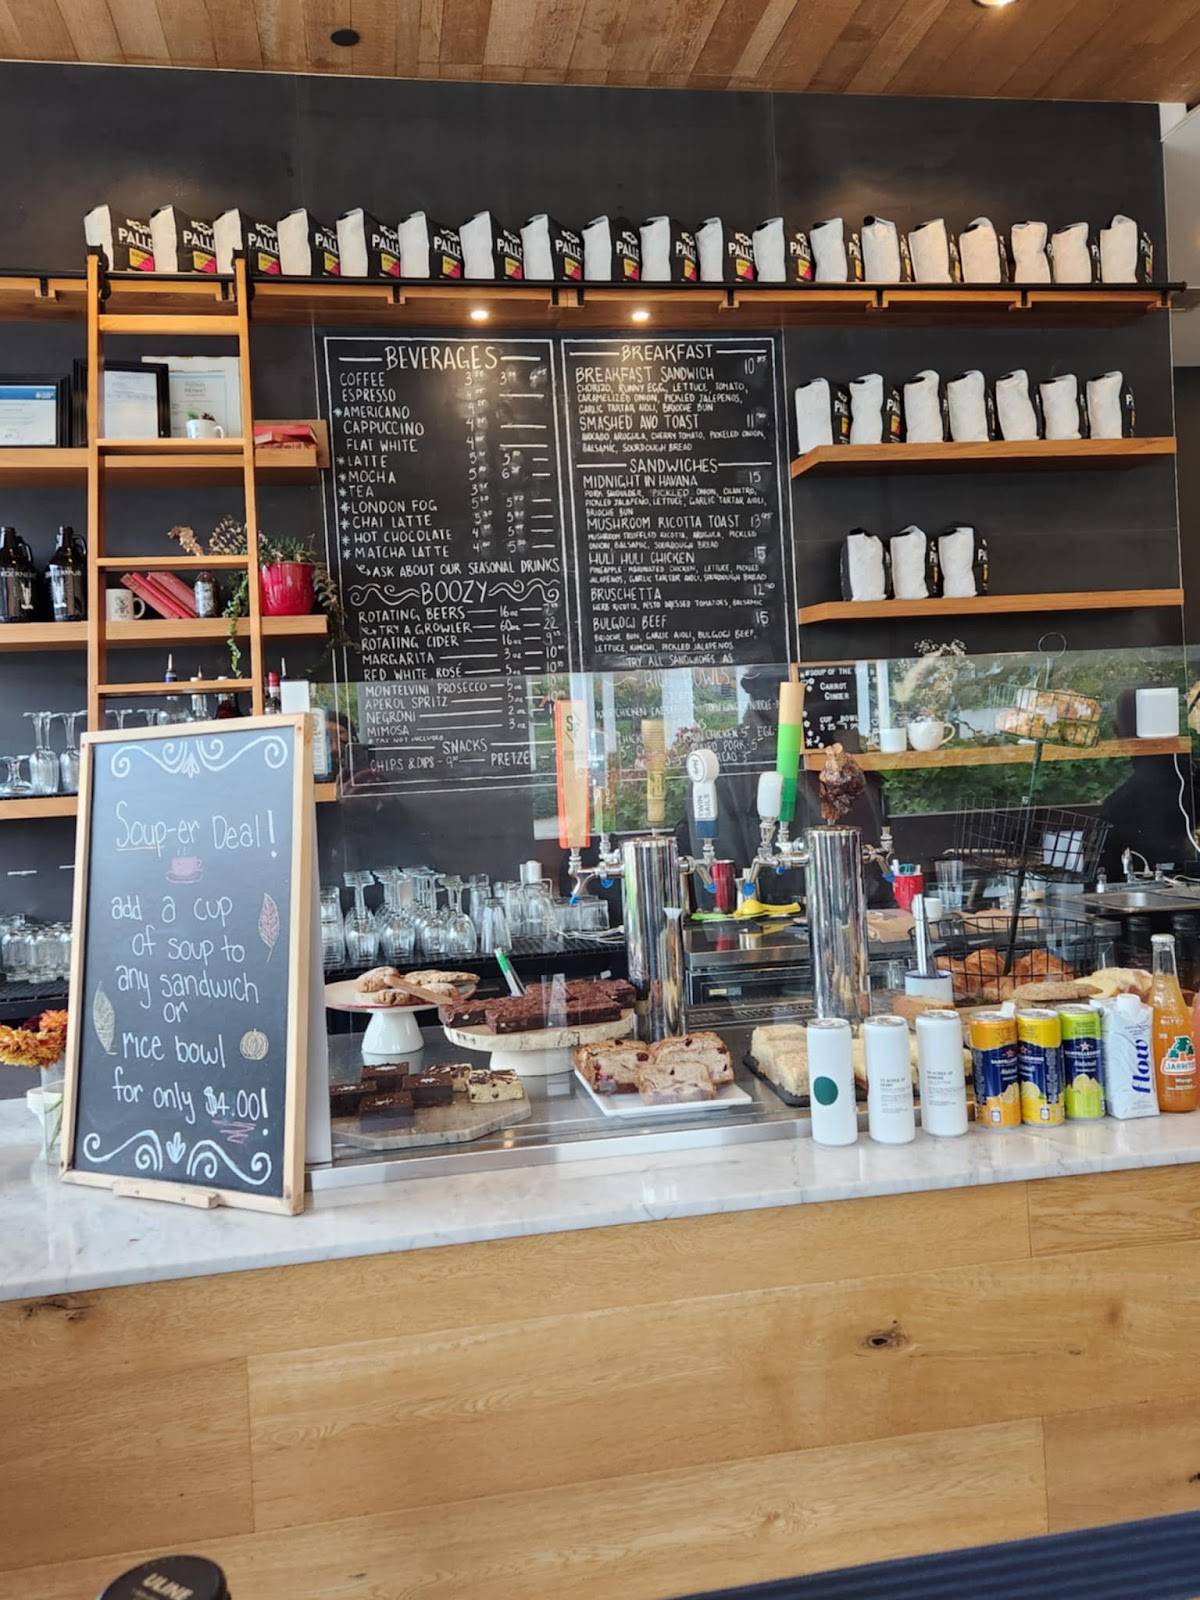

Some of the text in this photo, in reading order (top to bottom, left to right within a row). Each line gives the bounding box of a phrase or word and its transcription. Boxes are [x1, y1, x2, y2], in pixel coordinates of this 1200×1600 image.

[118, 227, 153, 251] PALLE
[183, 230, 214, 251] PALL
[247, 233, 279, 254] PALLE
[315, 233, 338, 253] PALL
[433, 236, 461, 258] PALLE
[497, 238, 523, 260] PALLE
[555, 239, 581, 260] PALLE
[616, 241, 639, 261] PALLE
[384, 345, 498, 371] BEVERAGES
[621, 344, 713, 363] BREAKFAST
[340, 372, 385, 387] COFFEE
[576, 366, 715, 384] BREAKFAST SANDWICH
[342, 388, 396, 403] ESPRESSO
[343, 406, 410, 420] AMERICANO
[343, 421, 424, 436] CAPPUCCINO
[579, 413, 700, 431] SMASHED AVO TOAST
[347, 439, 418, 452] FLAT WHITE
[348, 455, 388, 468] LATTE
[629, 458, 719, 474] SANDWICHES
[349, 471, 396, 484] MOCHA
[583, 475, 641, 489] MIDNIGHT
[659, 474, 699, 488] HAVANA
[349, 485, 374, 498] TEA
[352, 499, 438, 514] LONDON FOG
[353, 514, 432, 529] CHAI LATTE
[587, 514, 740, 531] MUSHROOM RICOTTA TOAST
[354, 529, 452, 543] HOT CHOCOLATE
[354, 545, 449, 559] MATCHA LATTE
[589, 552, 615, 565] HULI
[620, 552, 644, 565] HULI
[650, 551, 695, 565] CHICKEN
[372, 558, 560, 577] ASK ABOUT OUR SEASONAL DRINKS
[421, 580, 487, 605] BOOZY
[591, 587, 661, 602] BRUSCHETTA
[359, 609, 421, 623] ROTATING
[426, 606, 466, 620] BEERS
[642, 614, 668, 630] BEEF
[379, 625, 400, 635] TRY
[404, 625, 411, 634] A
[415, 622, 473, 634] GROWLER
[361, 636, 419, 651] ROTATING
[426, 634, 460, 648] CIDER
[362, 653, 434, 665] MARGARITA
[649, 655, 664, 667] ALL
[364, 669, 386, 681] RED
[436, 663, 462, 678] ROSÉ
[366, 682, 487, 697] MONTELVINI PROSECCO
[365, 696, 448, 710] APEROL SPRITZ
[367, 711, 416, 724] NEGRONI
[367, 725, 410, 738] MIMOSA
[442, 738, 488, 755] SNACKS
[370, 751, 533, 772] CHIPS PRETZE
[116, 801, 280, 858] Soup-er Deal!
[112, 896, 233, 926] add a cup
[132, 929, 246, 970] of soup to
[117, 965, 259, 1010] any sandwich
[164, 1000, 189, 1024] or
[123, 1033, 227, 1070] rice bowl
[1132, 1038, 1151, 1093] flow
[112, 1067, 269, 1136] for only $4.00!
